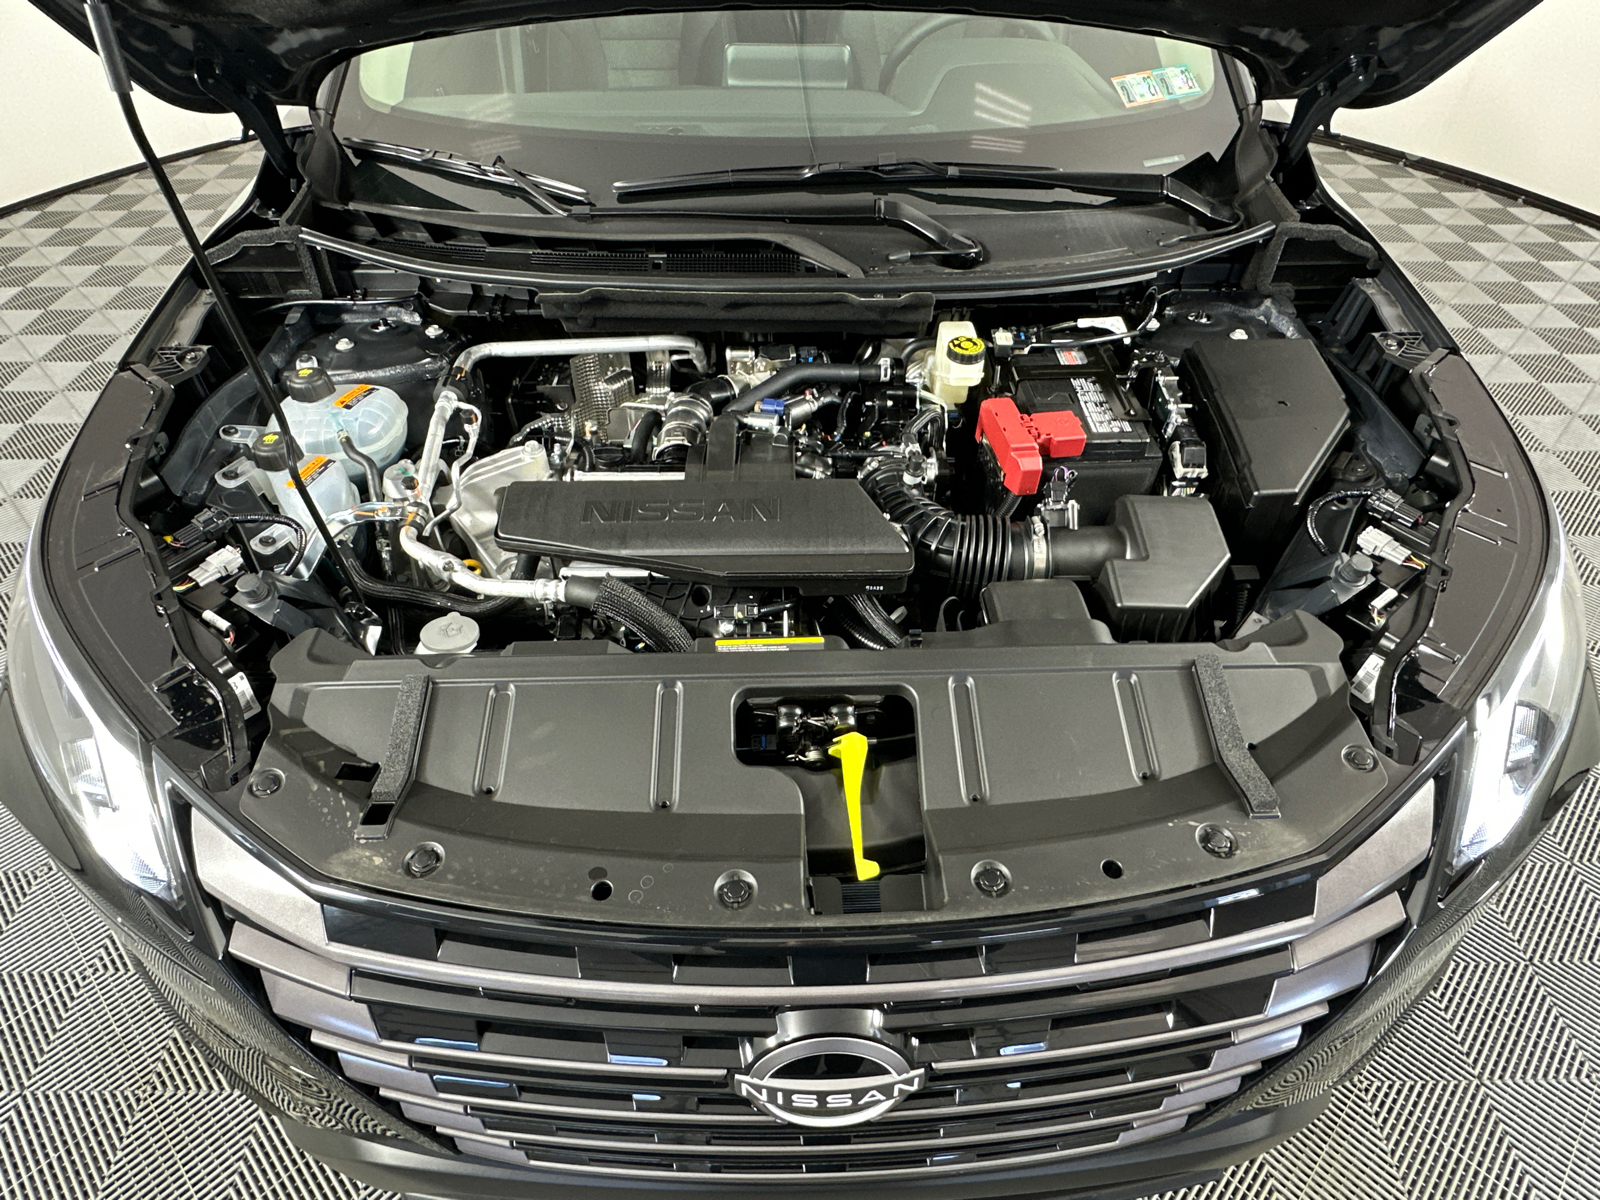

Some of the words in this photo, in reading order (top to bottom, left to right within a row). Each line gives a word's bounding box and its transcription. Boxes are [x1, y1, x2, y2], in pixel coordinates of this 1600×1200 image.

[1120, 85, 1135, 103] 2
[1160, 77, 1174, 96] 2
[580, 498, 781, 524] NISSAN
[740, 1077, 920, 1108] NISSAN
